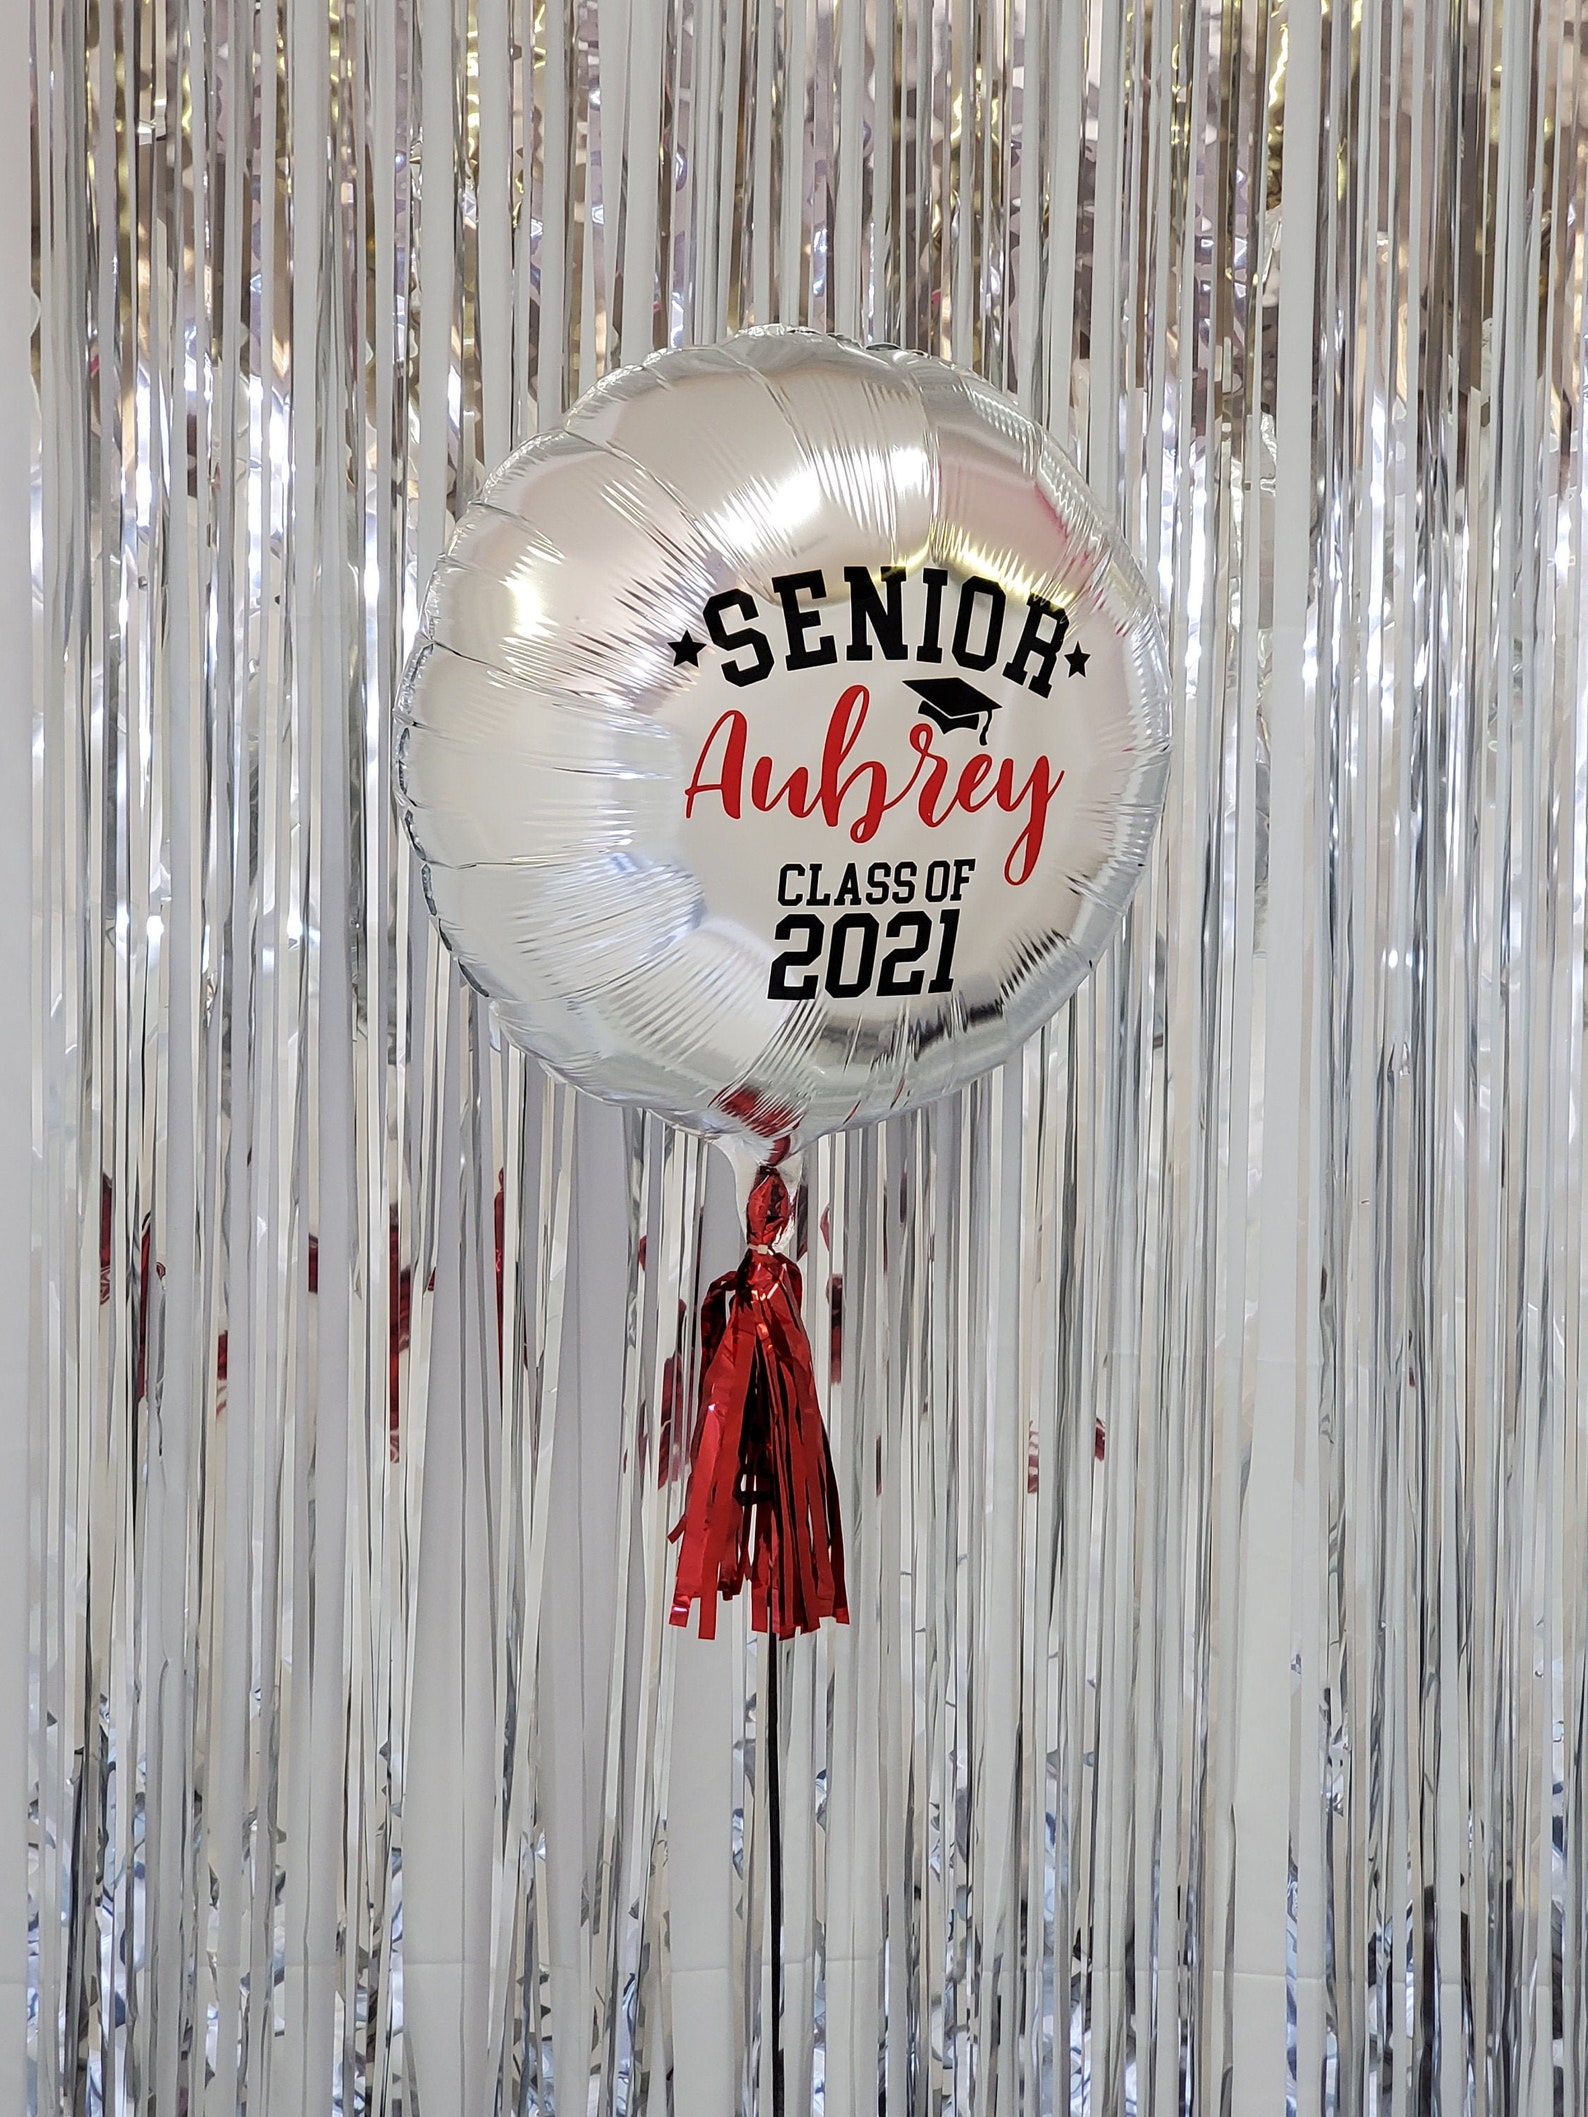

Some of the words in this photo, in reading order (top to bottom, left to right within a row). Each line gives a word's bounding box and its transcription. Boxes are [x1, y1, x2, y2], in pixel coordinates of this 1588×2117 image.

[702, 565, 1071, 699] SENIOR
[684, 684, 1063, 886] Aubrey
[777, 861, 918, 907] CLASS
[924, 858, 976, 903] OF
[767, 908, 961, 1001] 2021
